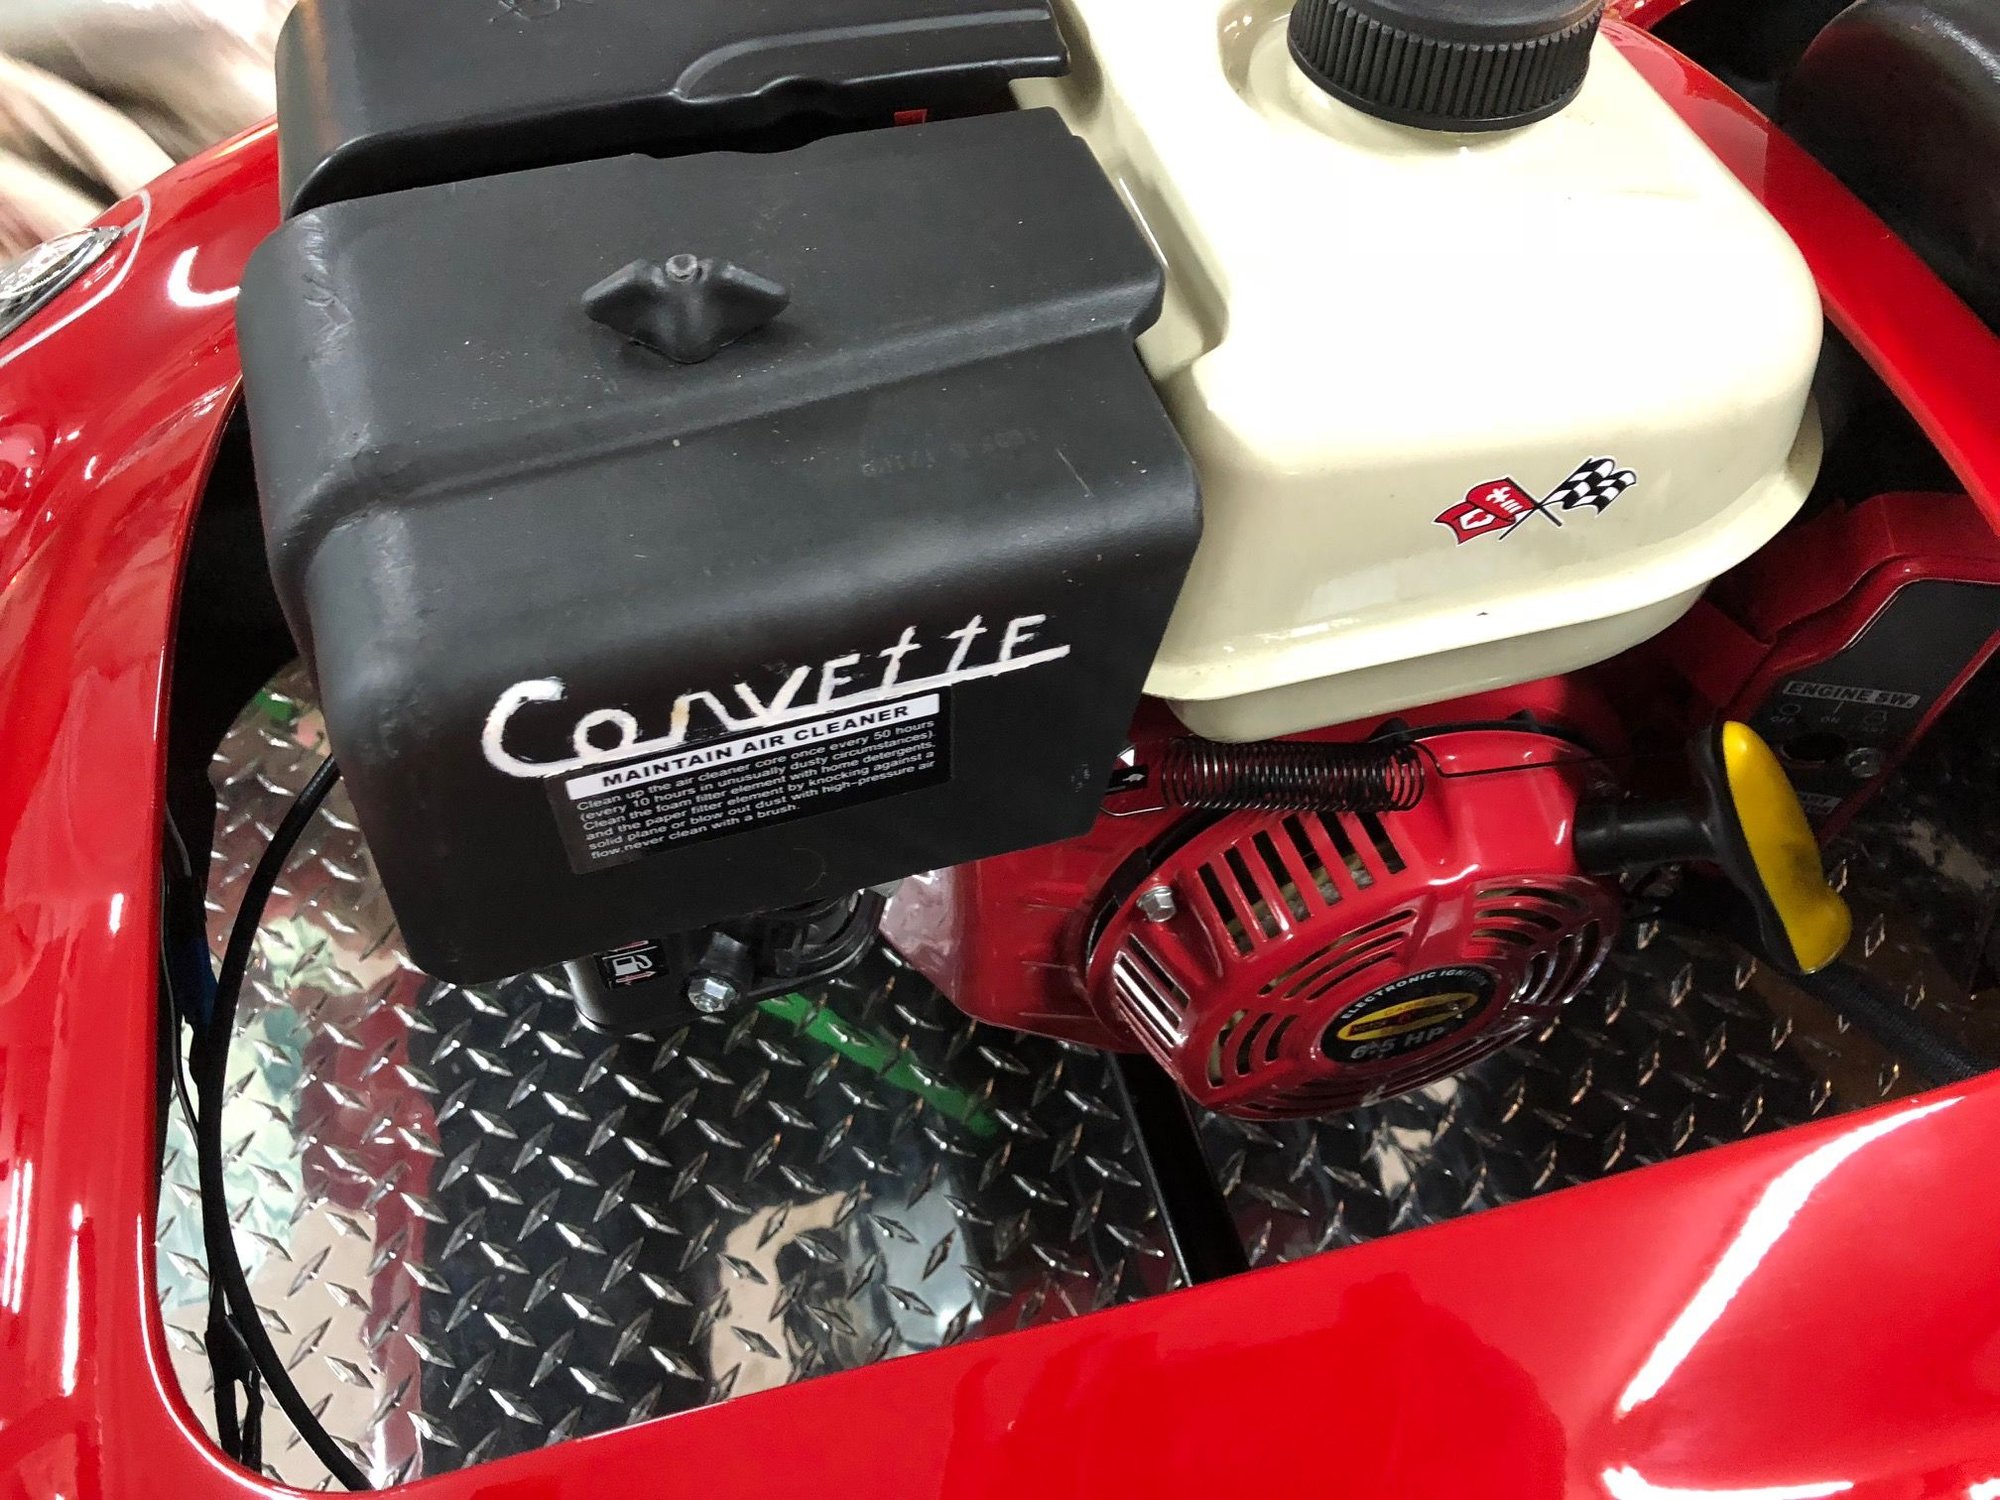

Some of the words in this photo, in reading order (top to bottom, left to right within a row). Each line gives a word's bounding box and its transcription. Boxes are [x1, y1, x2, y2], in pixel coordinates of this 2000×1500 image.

[1786, 682, 1873, 702] ENGINE
[1873, 692, 1913, 708] SW.
[577, 794, 621, 811] Clean
[625, 789, 645, 800] up
[648, 783, 672, 793] the
[675, 776, 694, 787] air
[698, 763, 751, 781] cleaner
[755, 755, 787, 768] core
[791, 746, 826, 760] once
[830, 735, 869, 751] every
[873, 729, 891, 740] 50
[895, 720, 935, 735] hours
[602, 747, 732, 787] MAINTAIN
[742, 735, 785, 754] AIR
[794, 706, 908, 741] CLEANER
[580, 804, 627, 822] (every
[632, 797, 650, 808] 10
[653, 787, 697, 802] hours
[700, 782, 714, 792] in
[717, 766, 787, 788] unusually
[790, 755, 828, 770] dusty
[583, 814, 626, 830] Clean
[629, 808, 653, 820] the
[656, 798, 692, 813] foam
[695, 789, 727, 803] filter
[730, 775, 786, 795] element
[790, 768, 818, 780] with
[821, 759, 859, 774] home
[586, 827, 614, 841] and
[618, 821, 641, 833] the
[645, 809, 687, 827] paper
[691, 801, 723, 815] filter
[727, 786, 784, 806] element
[787, 782, 805, 792] by
[808, 766, 870, 787] knocking
[873, 753, 922, 772] against
[588, 835, 623, 851] solid
[627, 825, 668, 842] plane
[671, 820, 686, 830] or
[690, 811, 724, 825] blow
[727, 804, 751, 816] out
[755, 795, 787, 810] dust
[791, 788, 819, 801] with
[918, 760, 936, 770] air
[668, 825, 708, 840] clean
[711, 817, 740, 830] with
[744, 814, 754, 822] a
[1341, 971, 1437, 1020] ELECTRONIC
[1403, 1026, 1445, 1047] HP
